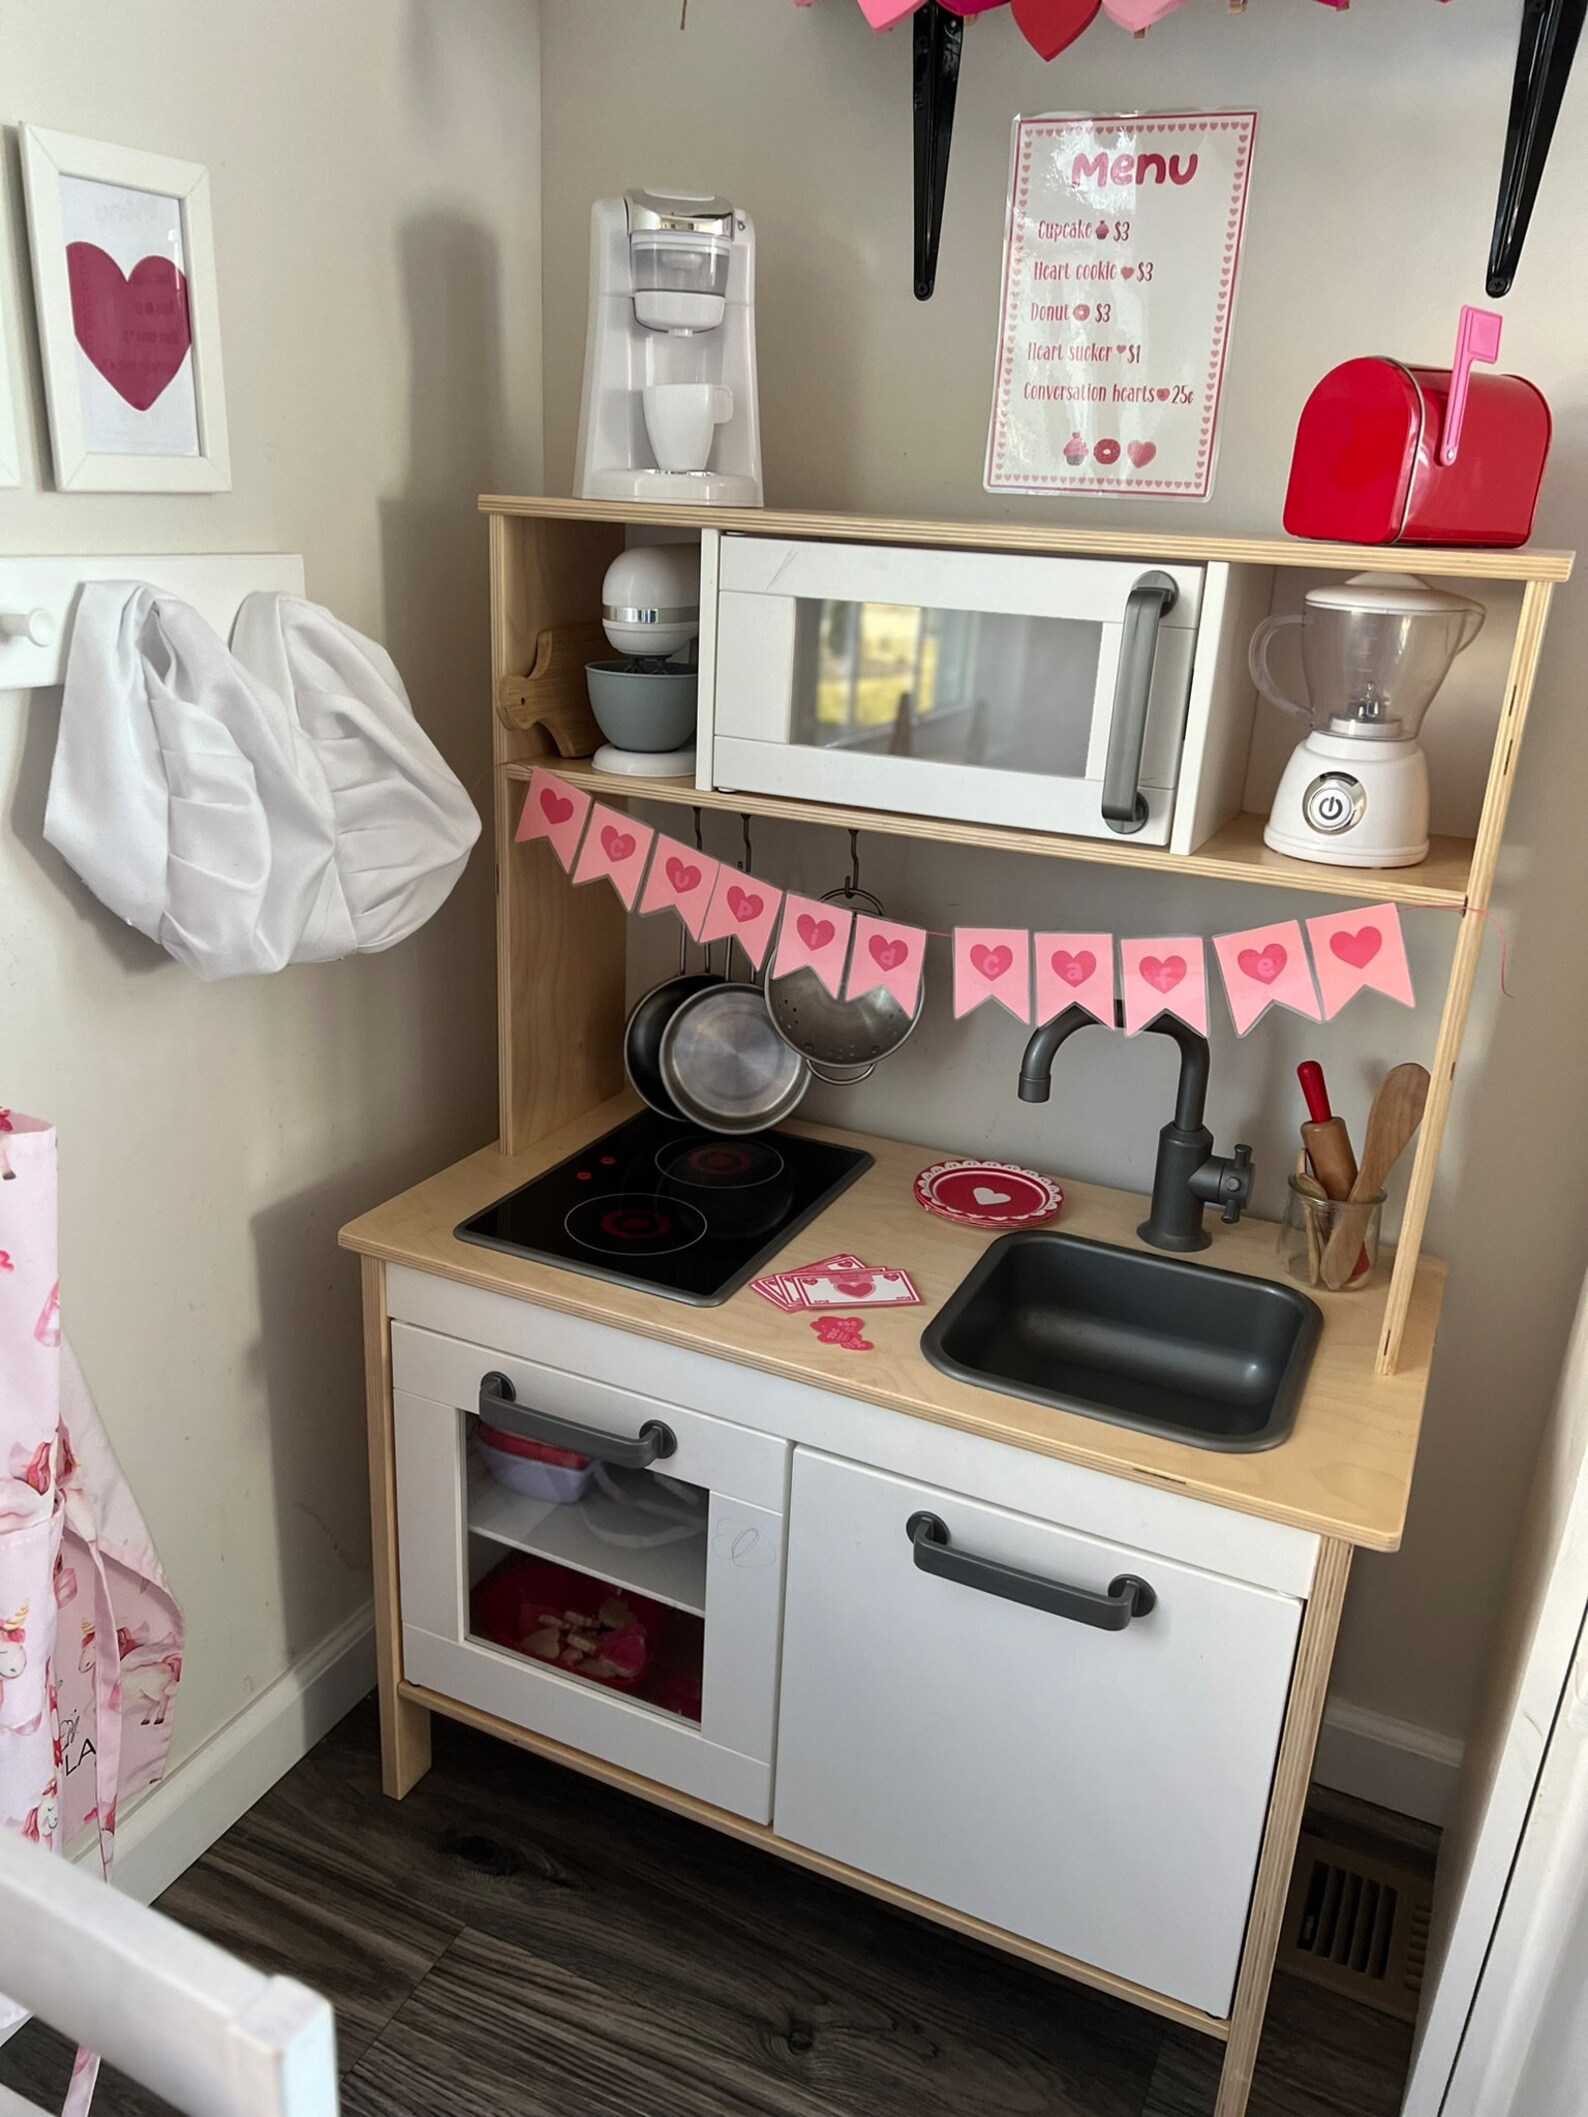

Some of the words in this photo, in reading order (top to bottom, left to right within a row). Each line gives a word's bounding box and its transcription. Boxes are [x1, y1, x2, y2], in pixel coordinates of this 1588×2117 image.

[1071, 152, 1198, 188] Menu
[1038, 220, 1092, 242] Cupcake
[1113, 221, 1130, 242] $3
[1034, 261, 1070, 281] Heart
[1075, 261, 1117, 281] cookie
[1136, 262, 1153, 282] $3
[1030, 303, 1069, 322] Donut
[1095, 303, 1111, 323] $3
[1027, 342, 1064, 361] Heart
[1069, 343, 1113, 362] sucker
[1127, 345, 1141, 364] $1
[1023, 382, 1107, 401] Conversation
[1112, 384, 1156, 403] hearts
